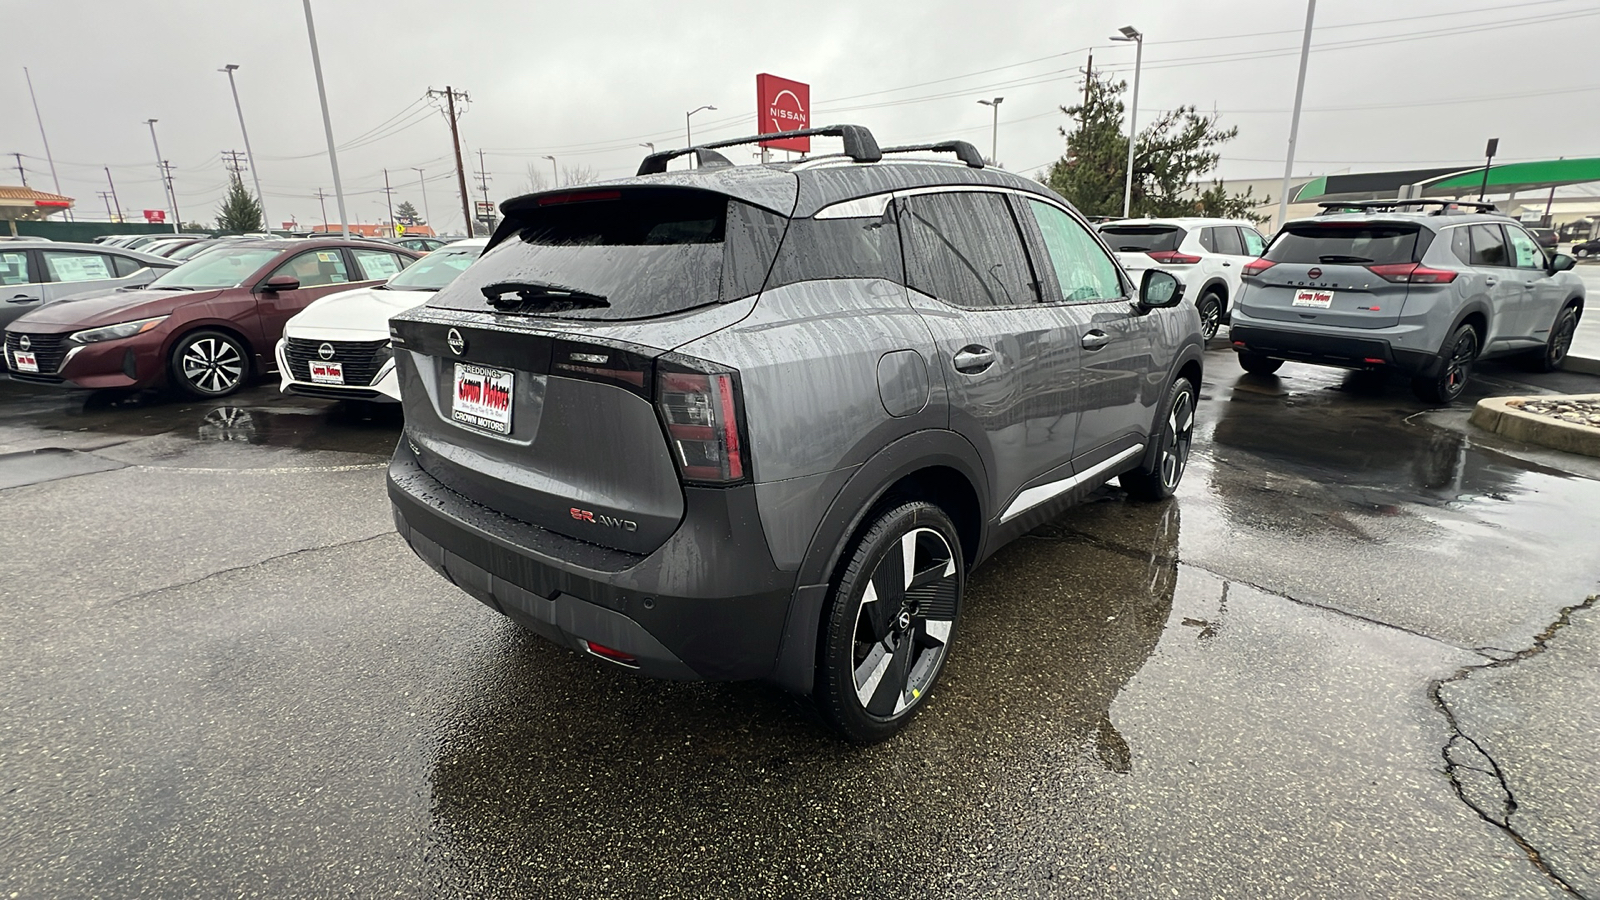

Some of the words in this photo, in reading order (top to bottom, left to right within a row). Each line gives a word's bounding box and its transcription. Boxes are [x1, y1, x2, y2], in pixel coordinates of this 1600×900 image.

[770, 107, 806, 122] NISSAN
[466, 365, 498, 378] REDDING
[458, 378, 482, 404] Crown
[482, 376, 509, 411] Motors
[455, 411, 477, 425] CROWN
[477, 417, 504, 432] MOTORS
[599, 514, 638, 532] AWD
